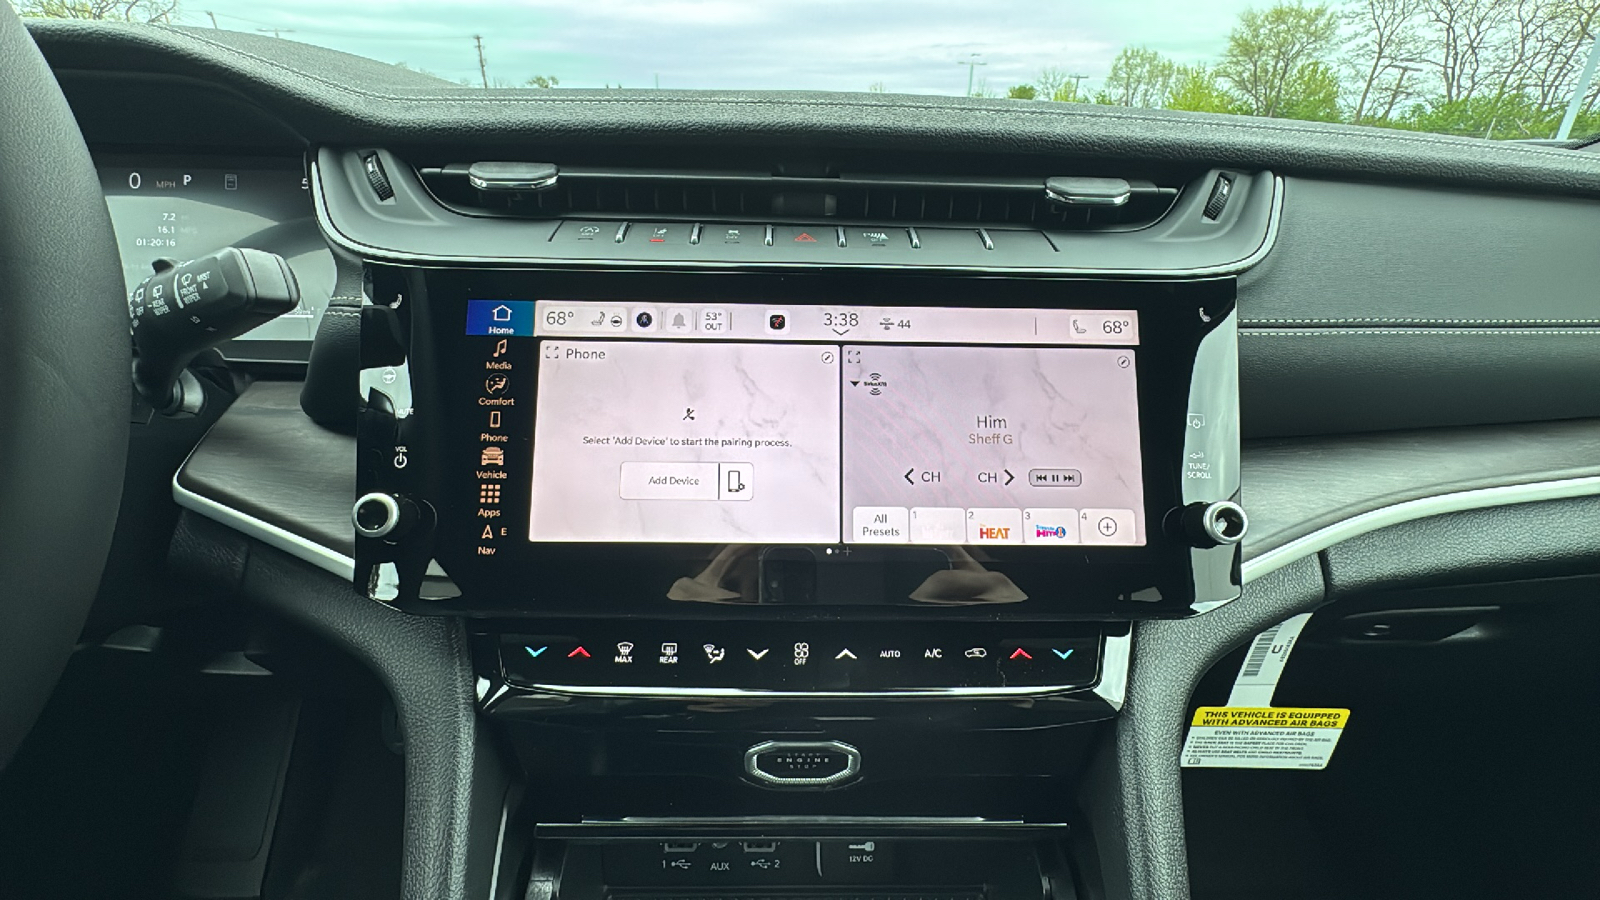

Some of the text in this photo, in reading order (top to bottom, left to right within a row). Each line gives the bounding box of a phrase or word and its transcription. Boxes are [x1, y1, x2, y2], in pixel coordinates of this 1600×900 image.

[129, 172, 141, 189] 0
[183, 174, 192, 186] P
[163, 213, 176, 221] 7.2
[157, 225, 175, 234] 16.1
[136, 238, 176, 247] 01:20:16
[546, 311, 574, 325] 68°
[705, 312, 722, 321] 53°
[823, 313, 859, 326] 3:38
[897, 320, 911, 329] 44
[1102, 320, 1129, 334] 68°
[566, 349, 606, 359] Phone
[485, 362, 512, 370] Media
[478, 397, 515, 406] Comfort
[977, 415, 1007, 429] Him
[480, 433, 509, 442] Phone
[583, 436, 610, 445] Select
[670, 438, 679, 446] to
[681, 438, 702, 446] start
[704, 438, 719, 446] the
[721, 438, 753, 448] pairing
[754, 439, 793, 448] process.
[968, 433, 1013, 445] Sheff G
[1188, 462, 1210, 470] TUNE/
[476, 471, 508, 479] Vehicle
[921, 471, 941, 483] CH
[978, 472, 998, 483] CH
[1187, 471, 1212, 479] SCROLL
[648, 476, 700, 486] Add Device
[477, 508, 501, 518] Apps
[912, 511, 917, 519] 1
[968, 511, 974, 520] 2
[1024, 511, 1031, 520] 3
[1081, 512, 1087, 521] 4
[874, 514, 888, 524] All
[501, 528, 507, 536] E
[862, 526, 900, 536] Presets
[979, 527, 1010, 539] HEAT
[477, 547, 496, 555] Nav
[880, 650, 901, 658] AUTO
[924, 649, 943, 659] A/C
[614, 656, 633, 664] MAX
[659, 656, 678, 664] REAR
[794, 658, 806, 666] OFF
[1205, 711, 1229, 719] THIS
[1231, 711, 1275, 719] VEHICLE
[1289, 712, 1341, 720] EQUIPPED
[1230, 719, 1288, 727] ADVANCED
[1291, 719, 1308, 727] AIR
[710, 862, 730, 871] AUX
[774, 860, 781, 869] 2
